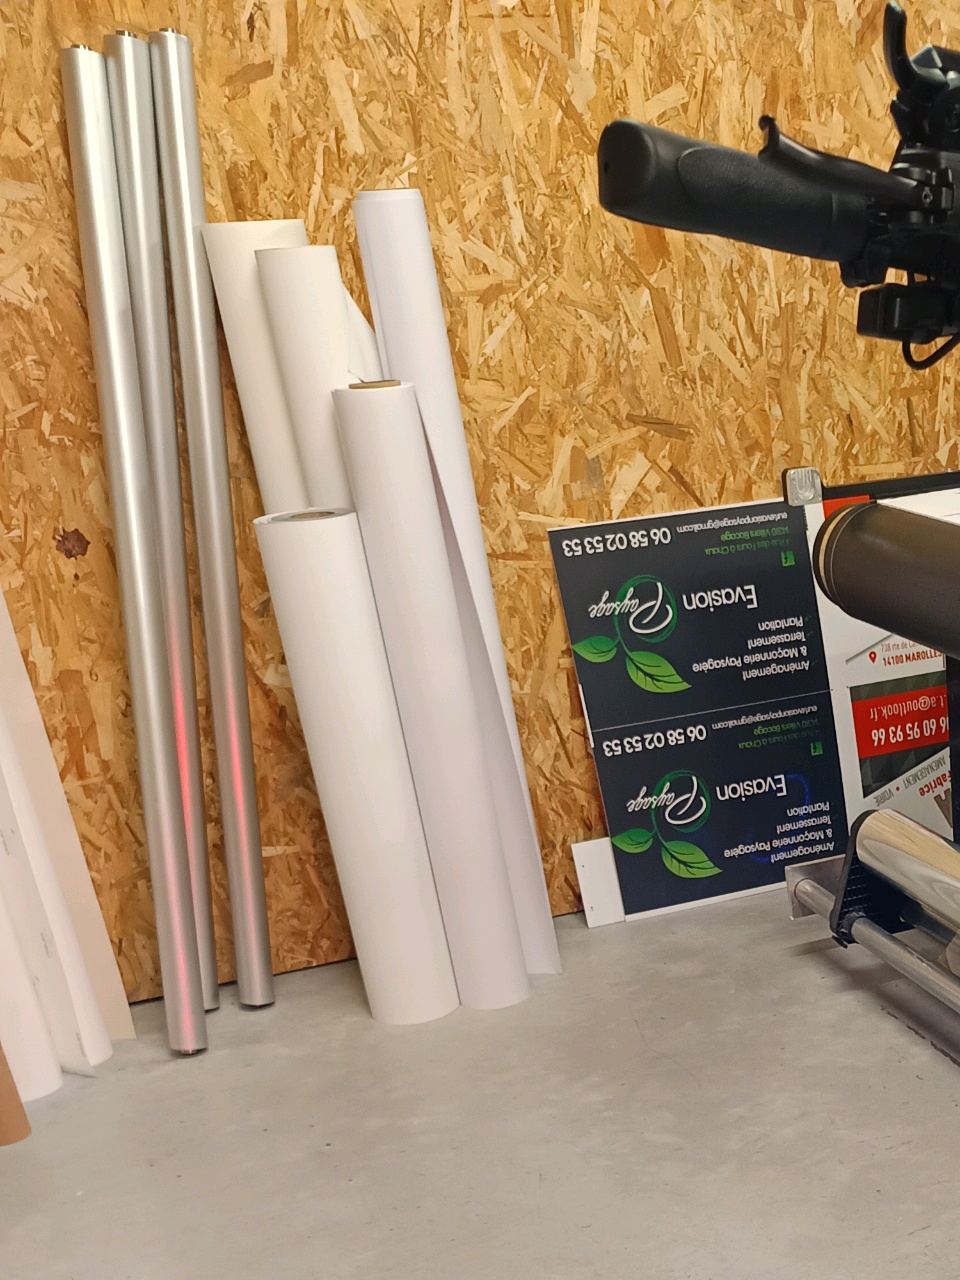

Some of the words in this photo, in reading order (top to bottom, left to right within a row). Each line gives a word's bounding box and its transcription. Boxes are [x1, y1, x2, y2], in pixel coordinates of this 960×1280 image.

[605, 533, 627, 550] 02
[629, 530, 648, 548] 58
[650, 528, 671, 545] 06
[721, 531, 750, 540] Bocage
[562, 539, 582, 556] 53
[584, 536, 603, 554] 53
[704, 546, 729, 554] Chaux
[683, 585, 757, 612] Evasion
[588, 582, 672, 633] Paysage
[758, 616, 803, 631] Plantation
[748, 632, 806, 650] Terrassement
[744, 647, 798, 664] Maçonnerie
[800, 646, 807, 656] &
[692, 657, 742, 672] Paysagère
[884, 656, 904, 665] 14100
[742, 660, 809, 680] Aménagement
[687, 725, 706, 742] 06
[754, 725, 781, 735] Bocage
[889, 725, 903, 743] 93
[906, 722, 920, 740] 95
[923, 719, 936, 736] 60
[624, 736, 642, 753] 53
[644, 732, 664, 749] 02
[667, 729, 684, 745] 58
[761, 738, 768, 746] à
[872, 728, 885, 746] 66
[603, 740, 621, 756] 53
[716, 774, 786, 801] Evasion
[627, 776, 706, 824] Paysage
[787, 802, 829, 816] Plantation
[777, 815, 831, 834] Terrassement
[826, 829, 832, 837] &
[772, 830, 824, 848] Maçonnerie
[724, 842, 770, 858] Paysagère
[769, 842, 834, 863] Aménagement
